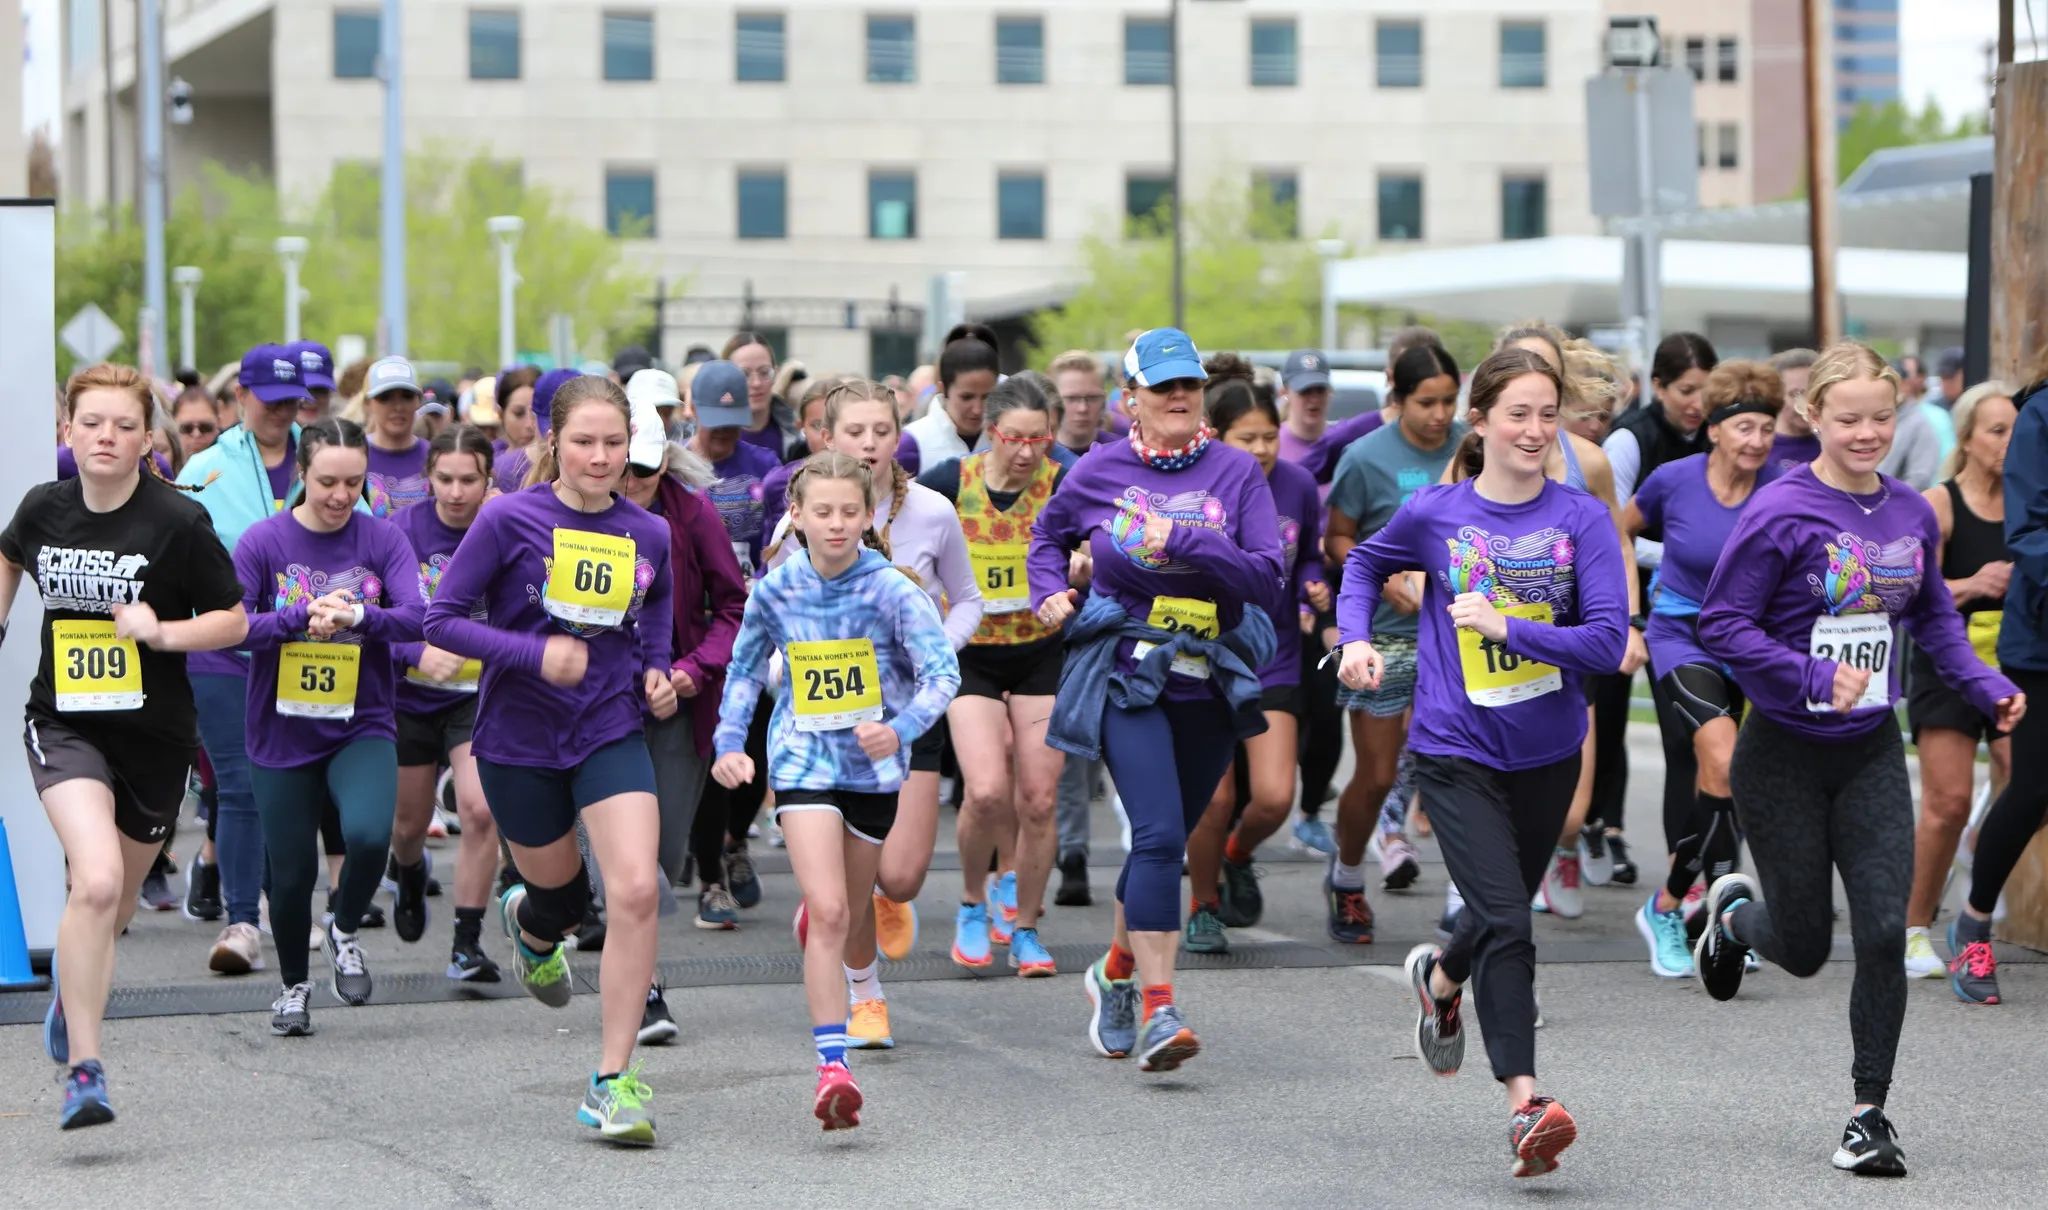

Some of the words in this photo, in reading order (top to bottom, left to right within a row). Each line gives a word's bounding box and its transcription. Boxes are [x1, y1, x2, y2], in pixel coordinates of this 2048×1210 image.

[47, 547, 115, 577] CROSS
[560, 541, 589, 552] MONTANA
[590, 546, 617, 557] WOMEN'S
[618, 550, 630, 558] RUN
[46, 572, 144, 605] COUNTRY
[574, 559, 613, 595] 66
[987, 566, 1014, 589] 51
[90, 632, 117, 640] WOMEN'S
[68, 646, 126, 680] 309
[824, 652, 854, 660] WOMEN'S
[855, 649, 869, 657] RUN
[300, 665, 336, 692] 53
[804, 665, 865, 700] 254
